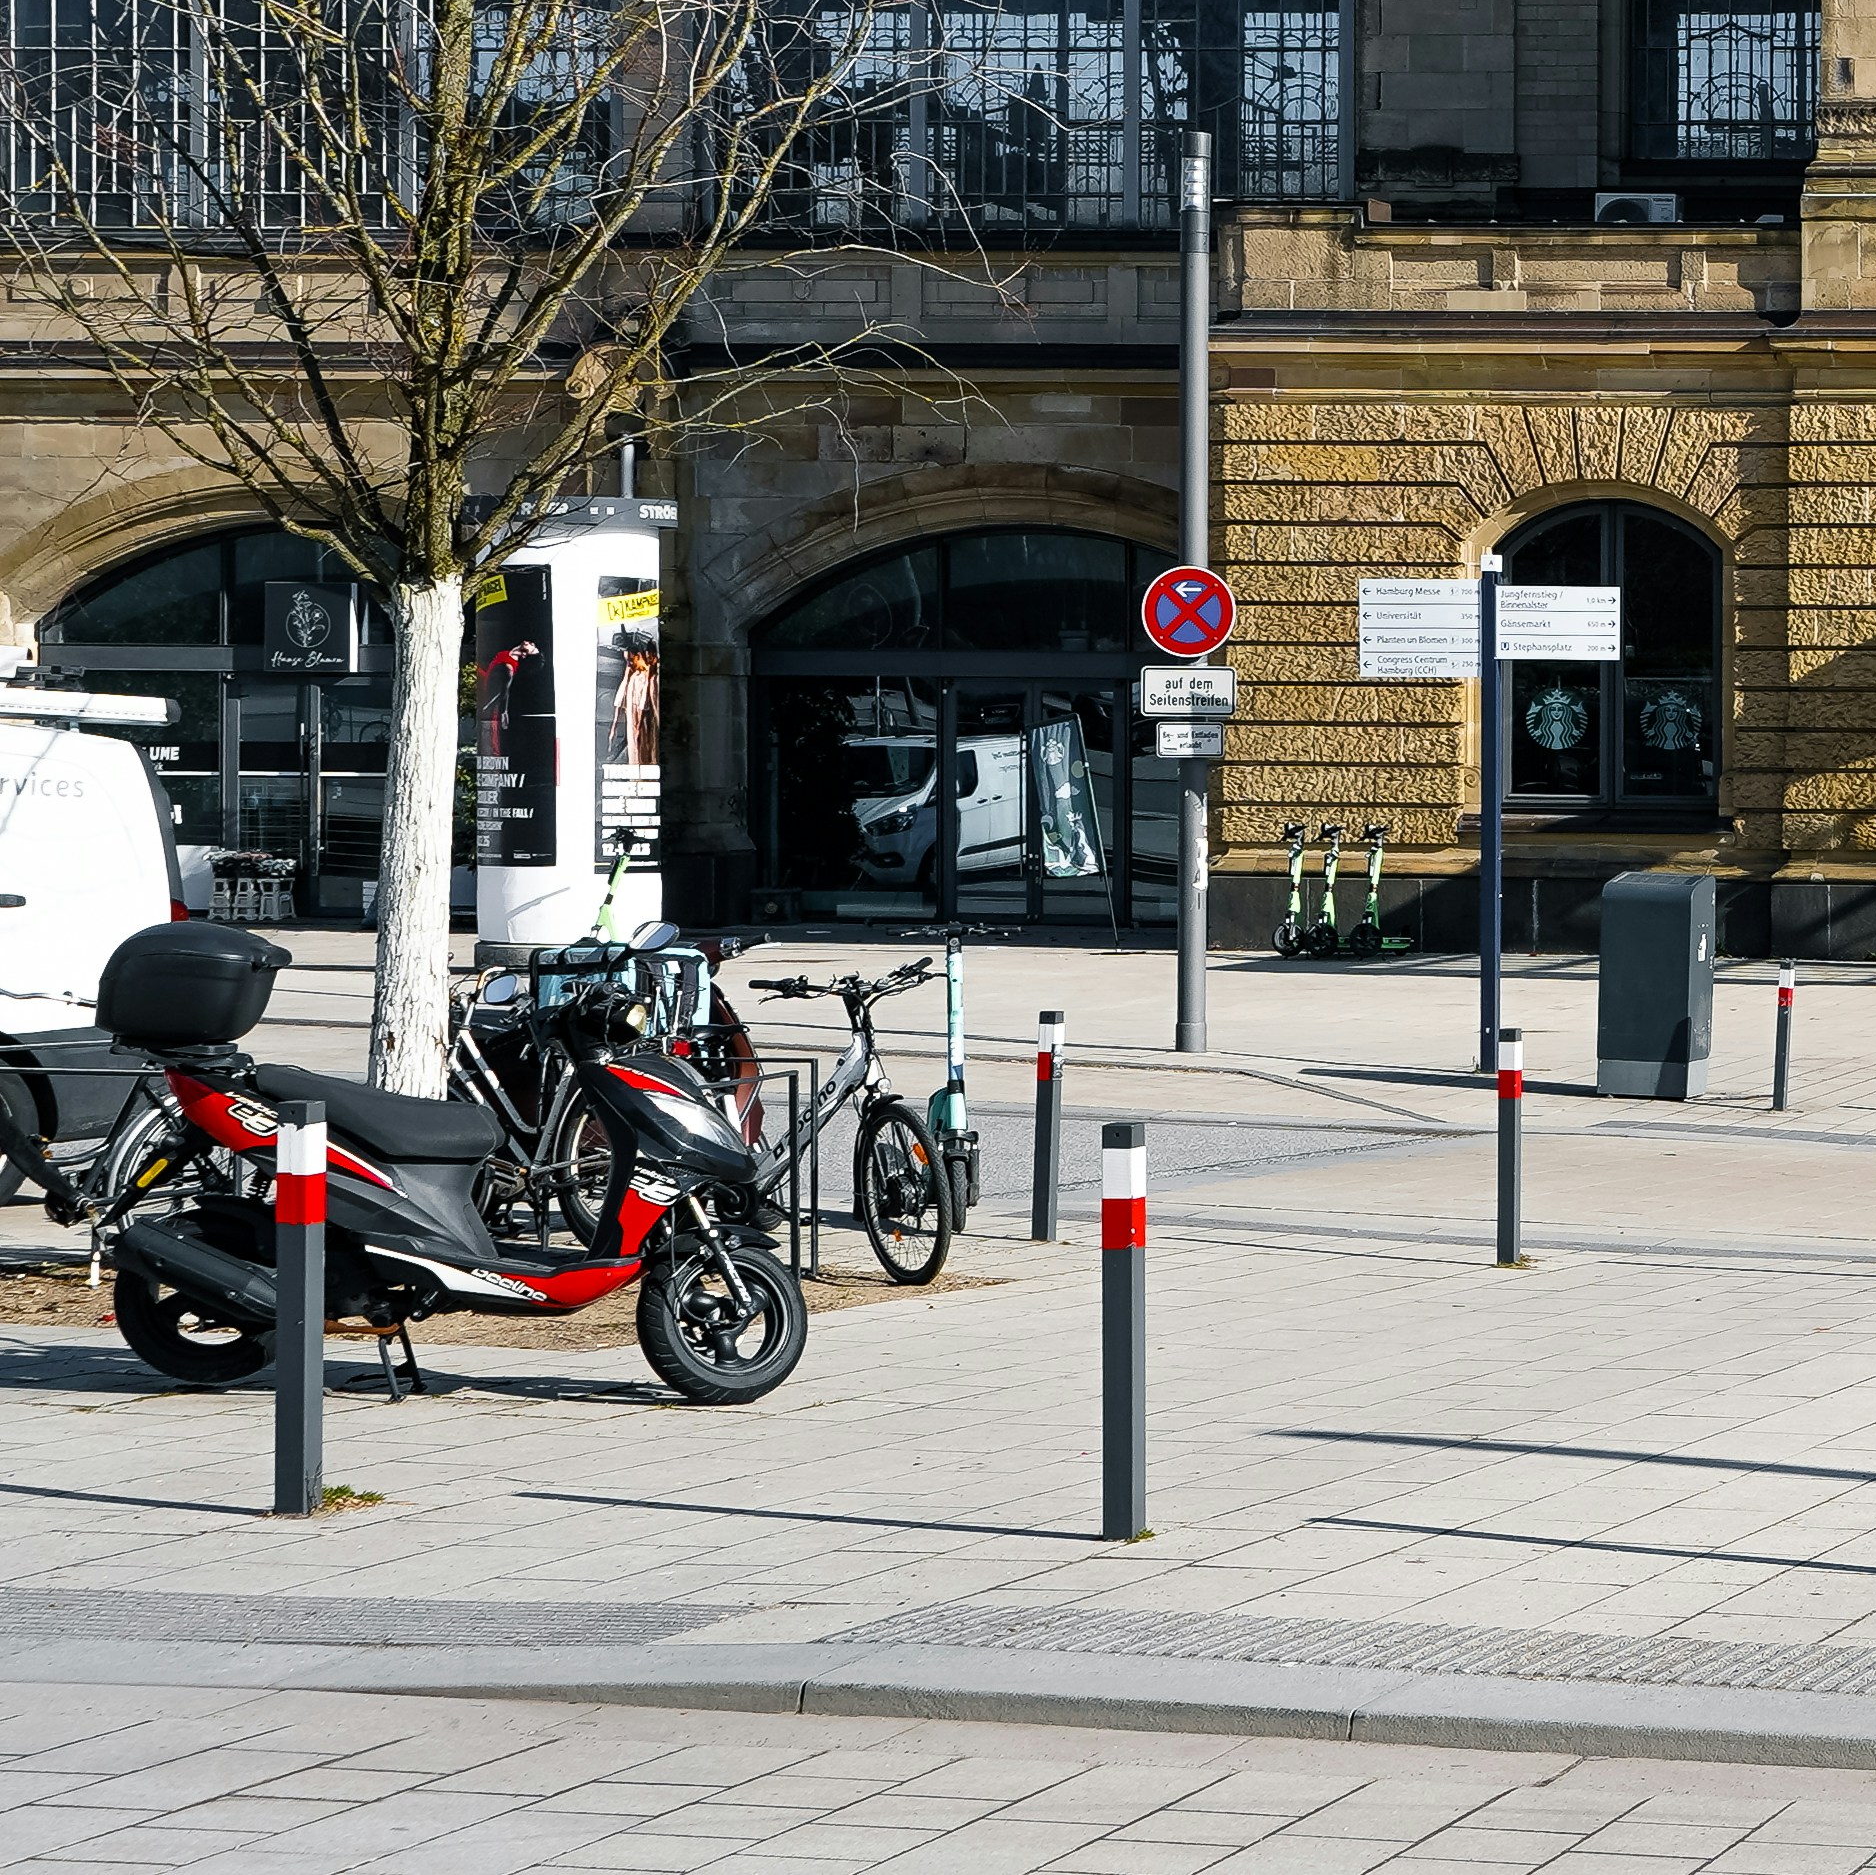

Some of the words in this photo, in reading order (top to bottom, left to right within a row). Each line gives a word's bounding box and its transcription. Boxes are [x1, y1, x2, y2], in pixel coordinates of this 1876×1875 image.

[1376, 587, 1413, 597] Hamburg
[1500, 590, 1557, 600] Jungfernstieg
[1500, 600, 1548, 609] Binnenalster
[1376, 611, 1421, 620] Universität
[1500, 619, 1551, 628] Gänsemarkt
[1376, 635, 1406, 644] Planten
[1418, 635, 1448, 644] Blomen
[1513, 642, 1572, 652] Stephansplatz
[1377, 655, 1413, 665] Congress
[1414, 655, 1448, 664] Centrum
[1377, 666, 1413, 676] Hamburg
[1414, 666, 1437, 675] (CCH)
[1165, 677, 1183, 689] auf
[1189, 677, 1213, 689] dem
[1149, 693, 1229, 706] Seitenstreifen
